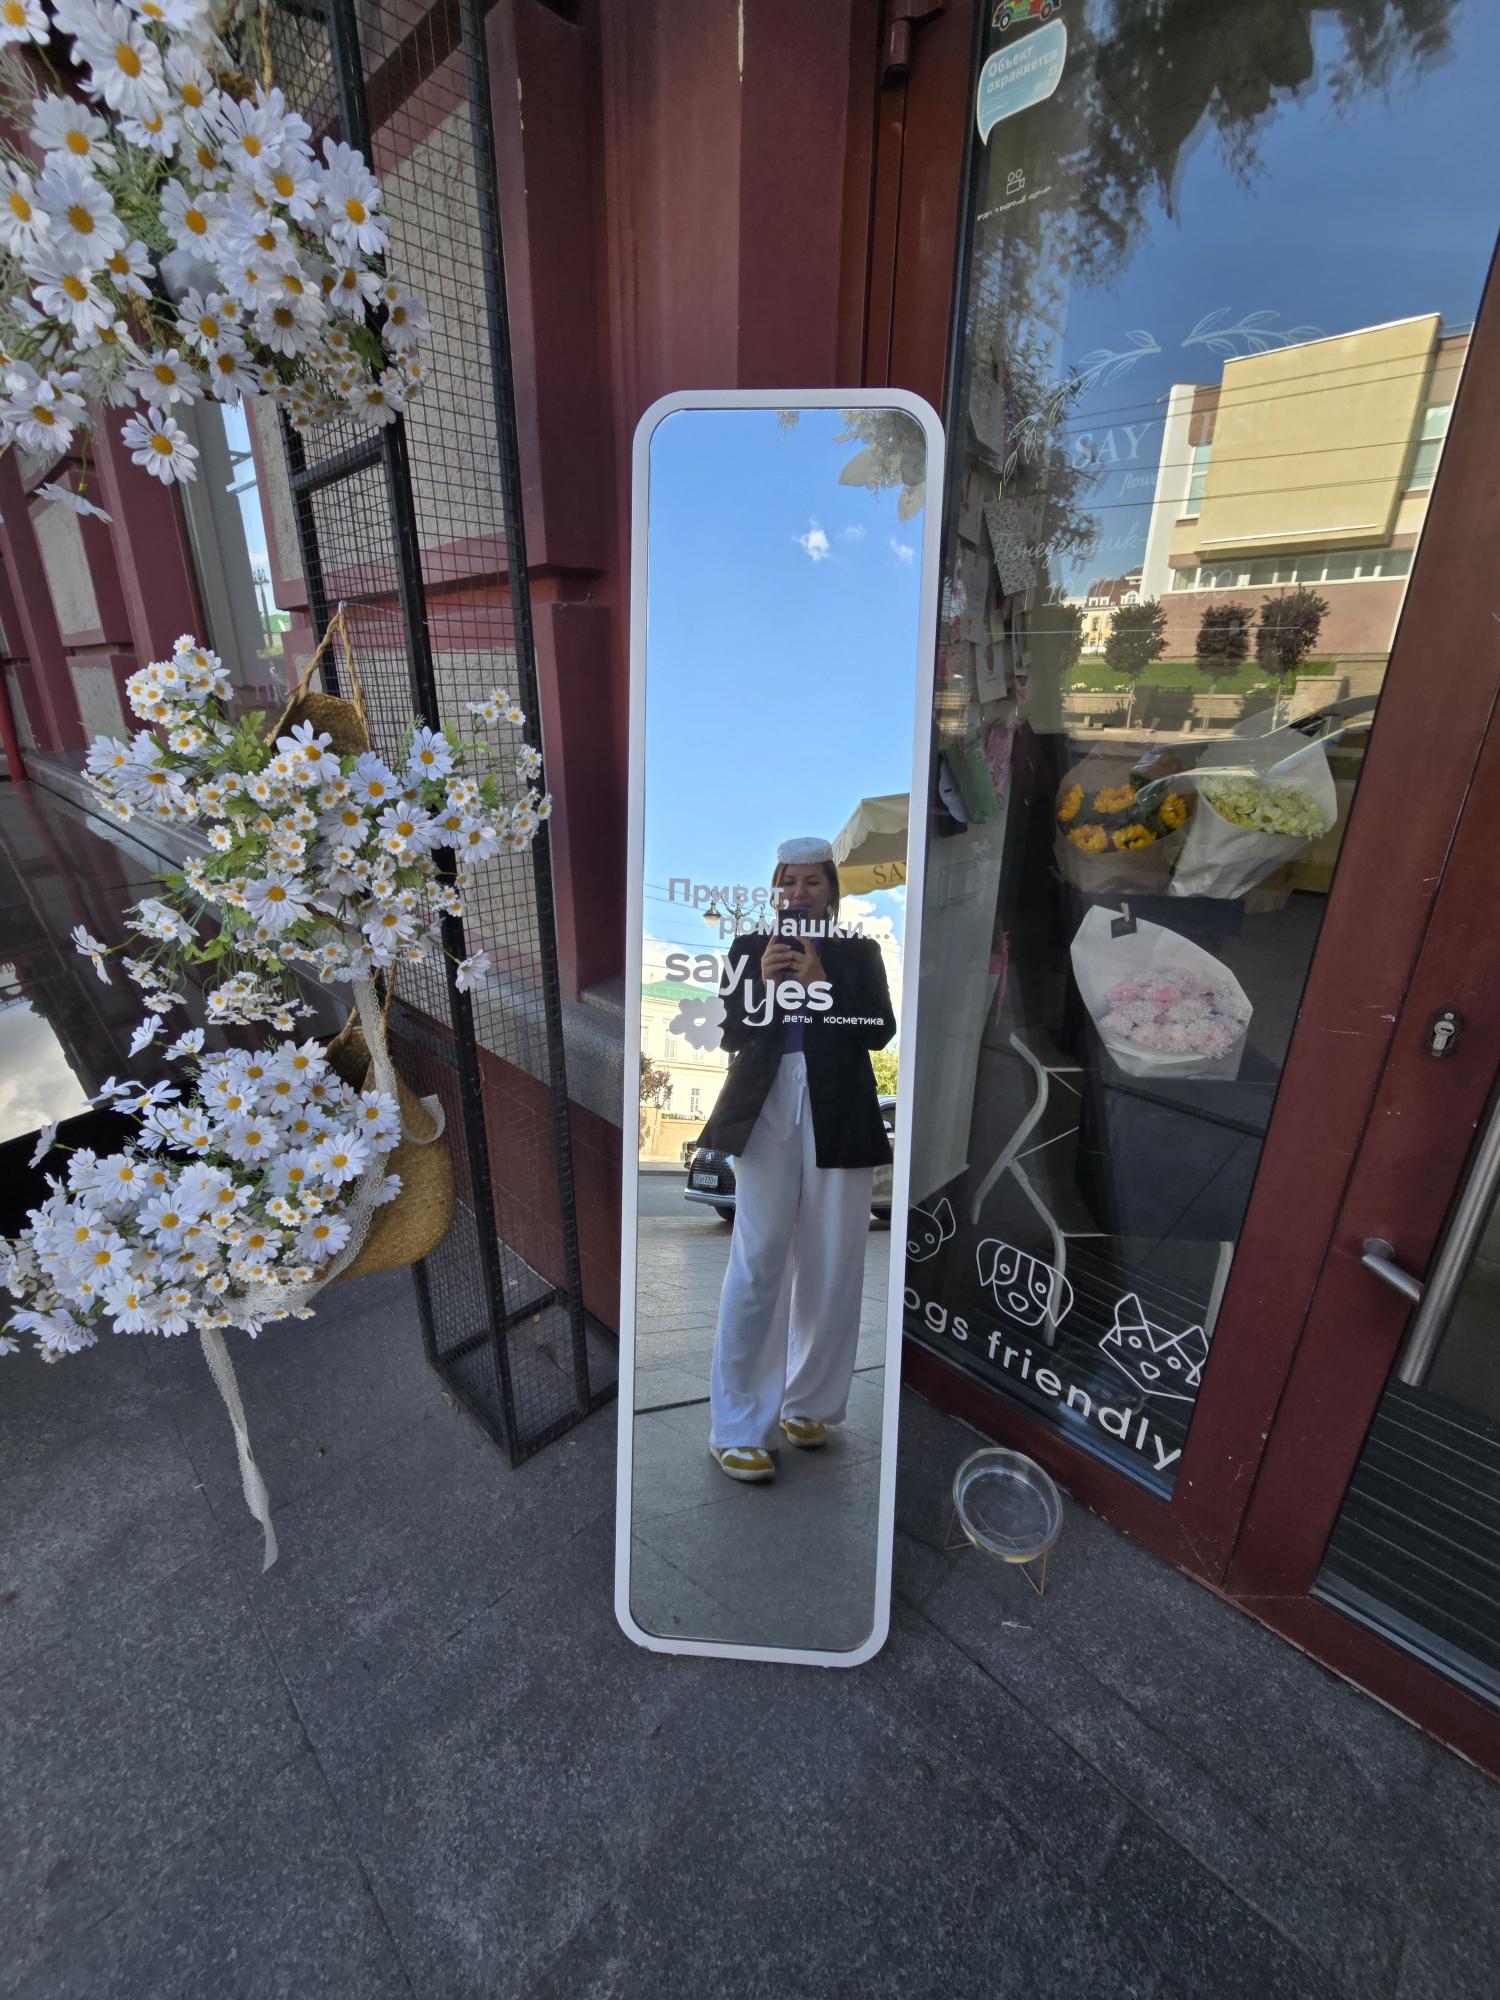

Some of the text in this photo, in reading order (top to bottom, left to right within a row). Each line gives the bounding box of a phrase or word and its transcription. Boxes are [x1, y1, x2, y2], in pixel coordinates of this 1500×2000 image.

[987, 49, 1058, 93] охраняется
[988, 45, 1034, 77] Объект
[1071, 422, 1155, 469] SAY
[668, 878, 790, 908] Привет,
[872, 861, 906, 885] SA
[665, 952, 749, 996] say
[741, 978, 834, 1027] yes
[782, 1014, 885, 1026] веты косметика
[903, 1285, 1182, 1471] ogs friendly
